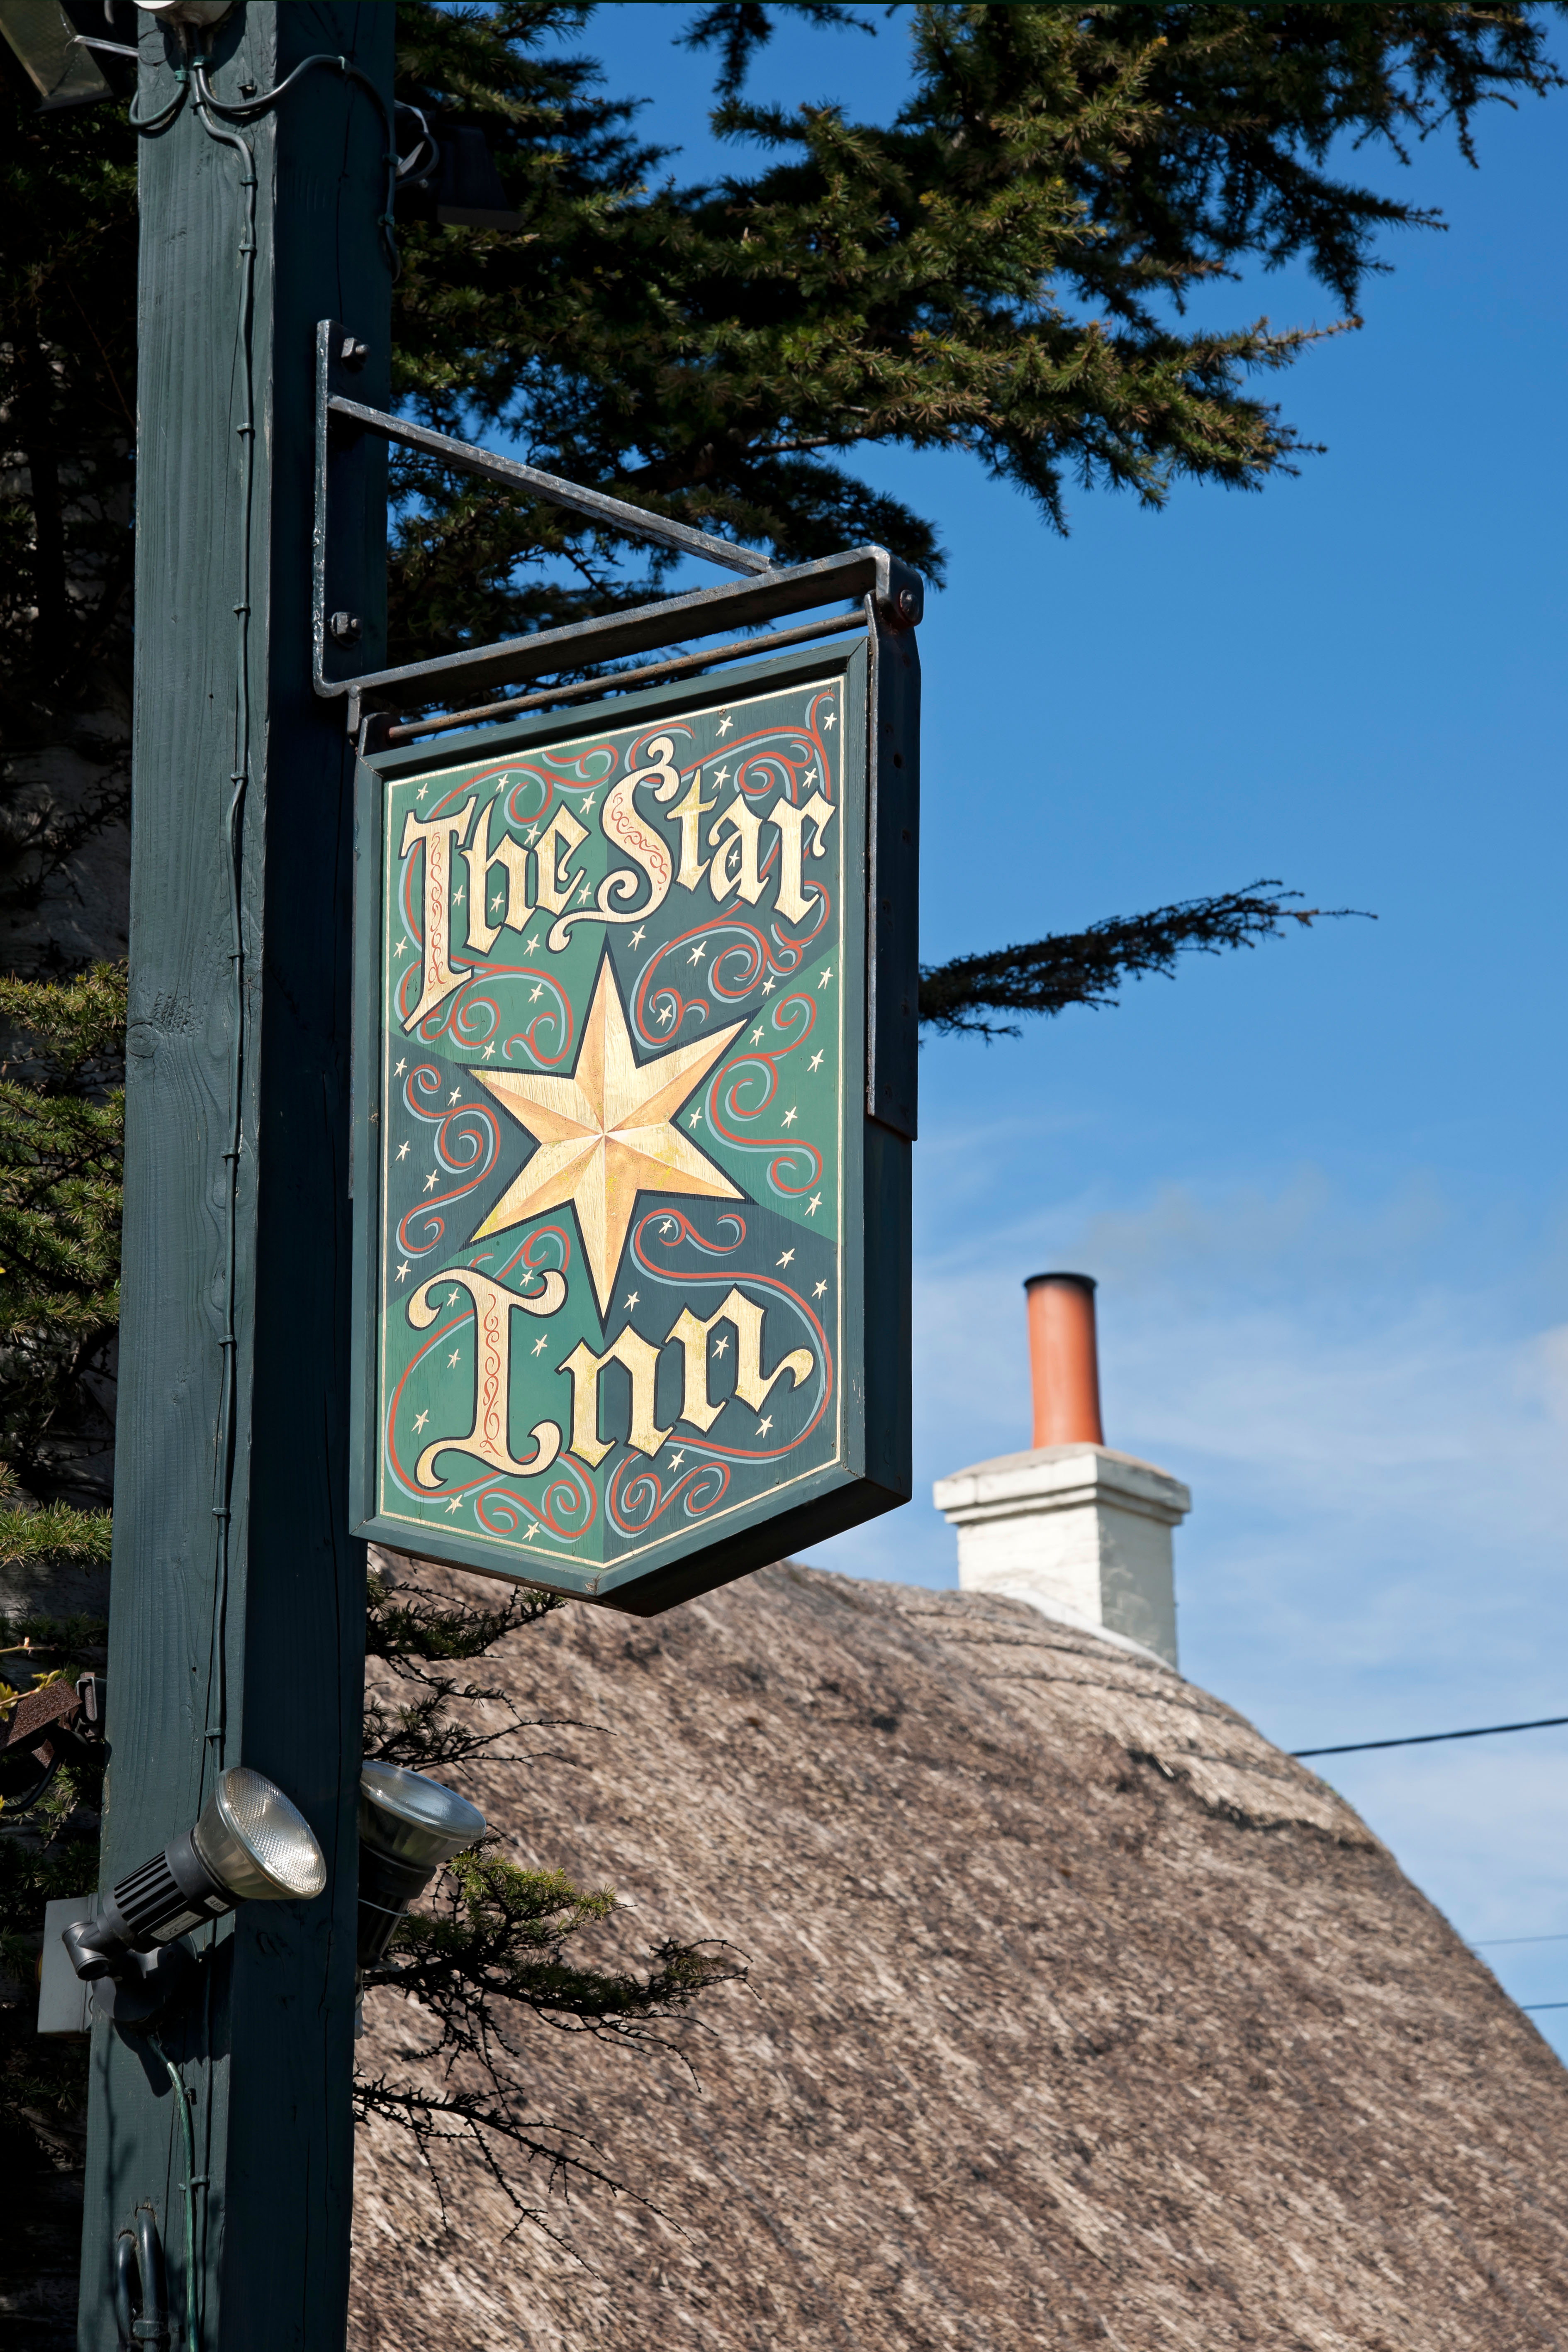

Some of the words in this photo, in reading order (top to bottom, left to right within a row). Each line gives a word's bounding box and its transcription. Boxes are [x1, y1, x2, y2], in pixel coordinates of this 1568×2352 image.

[399, 793, 590, 1036] The
[546, 736, 837, 953] Star
[406, 1266, 814, 1490] Inn
[209, 1900, 224, 1909] 489
